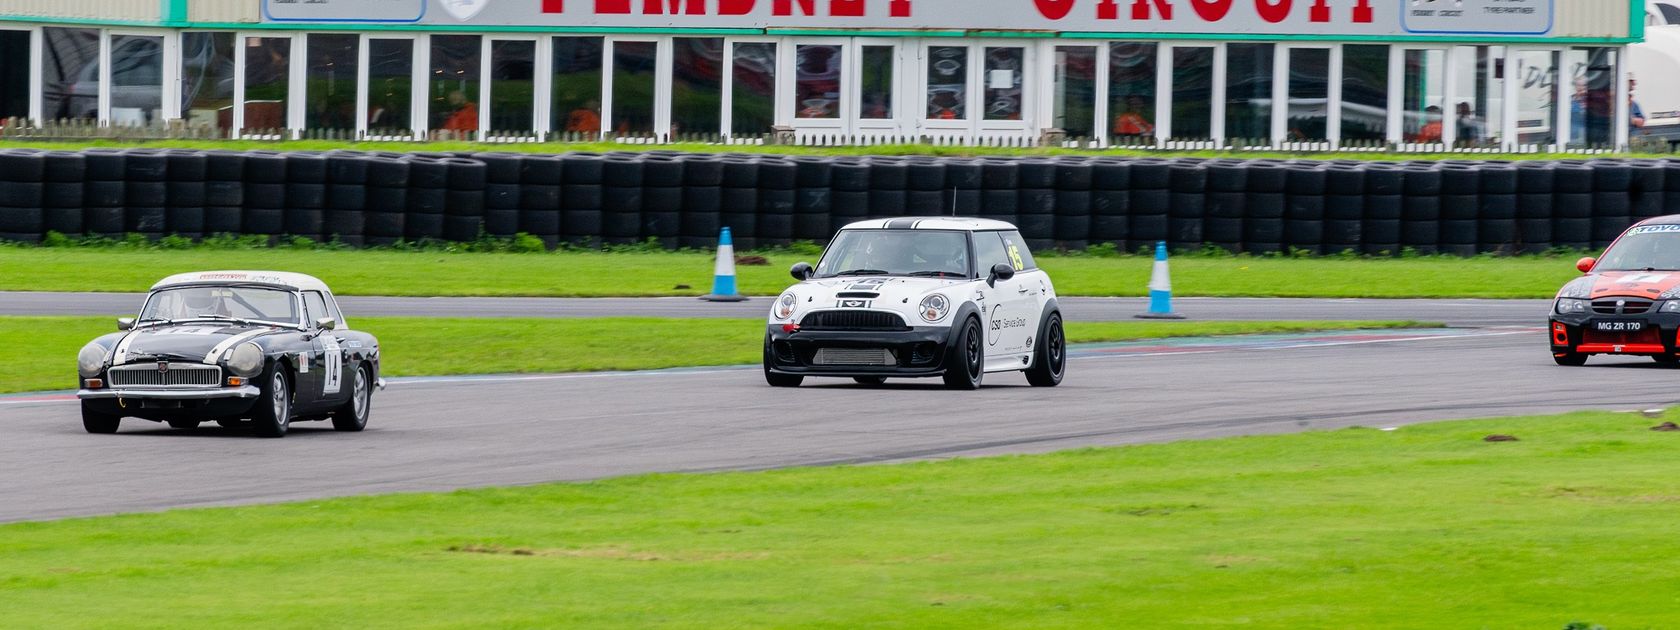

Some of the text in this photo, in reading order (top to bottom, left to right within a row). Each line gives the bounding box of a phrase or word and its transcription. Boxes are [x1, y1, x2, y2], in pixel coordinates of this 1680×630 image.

[1008, 245, 1024, 270] 15
[1597, 322, 1641, 330] MG ZR 170
[328, 353, 338, 386] 14
